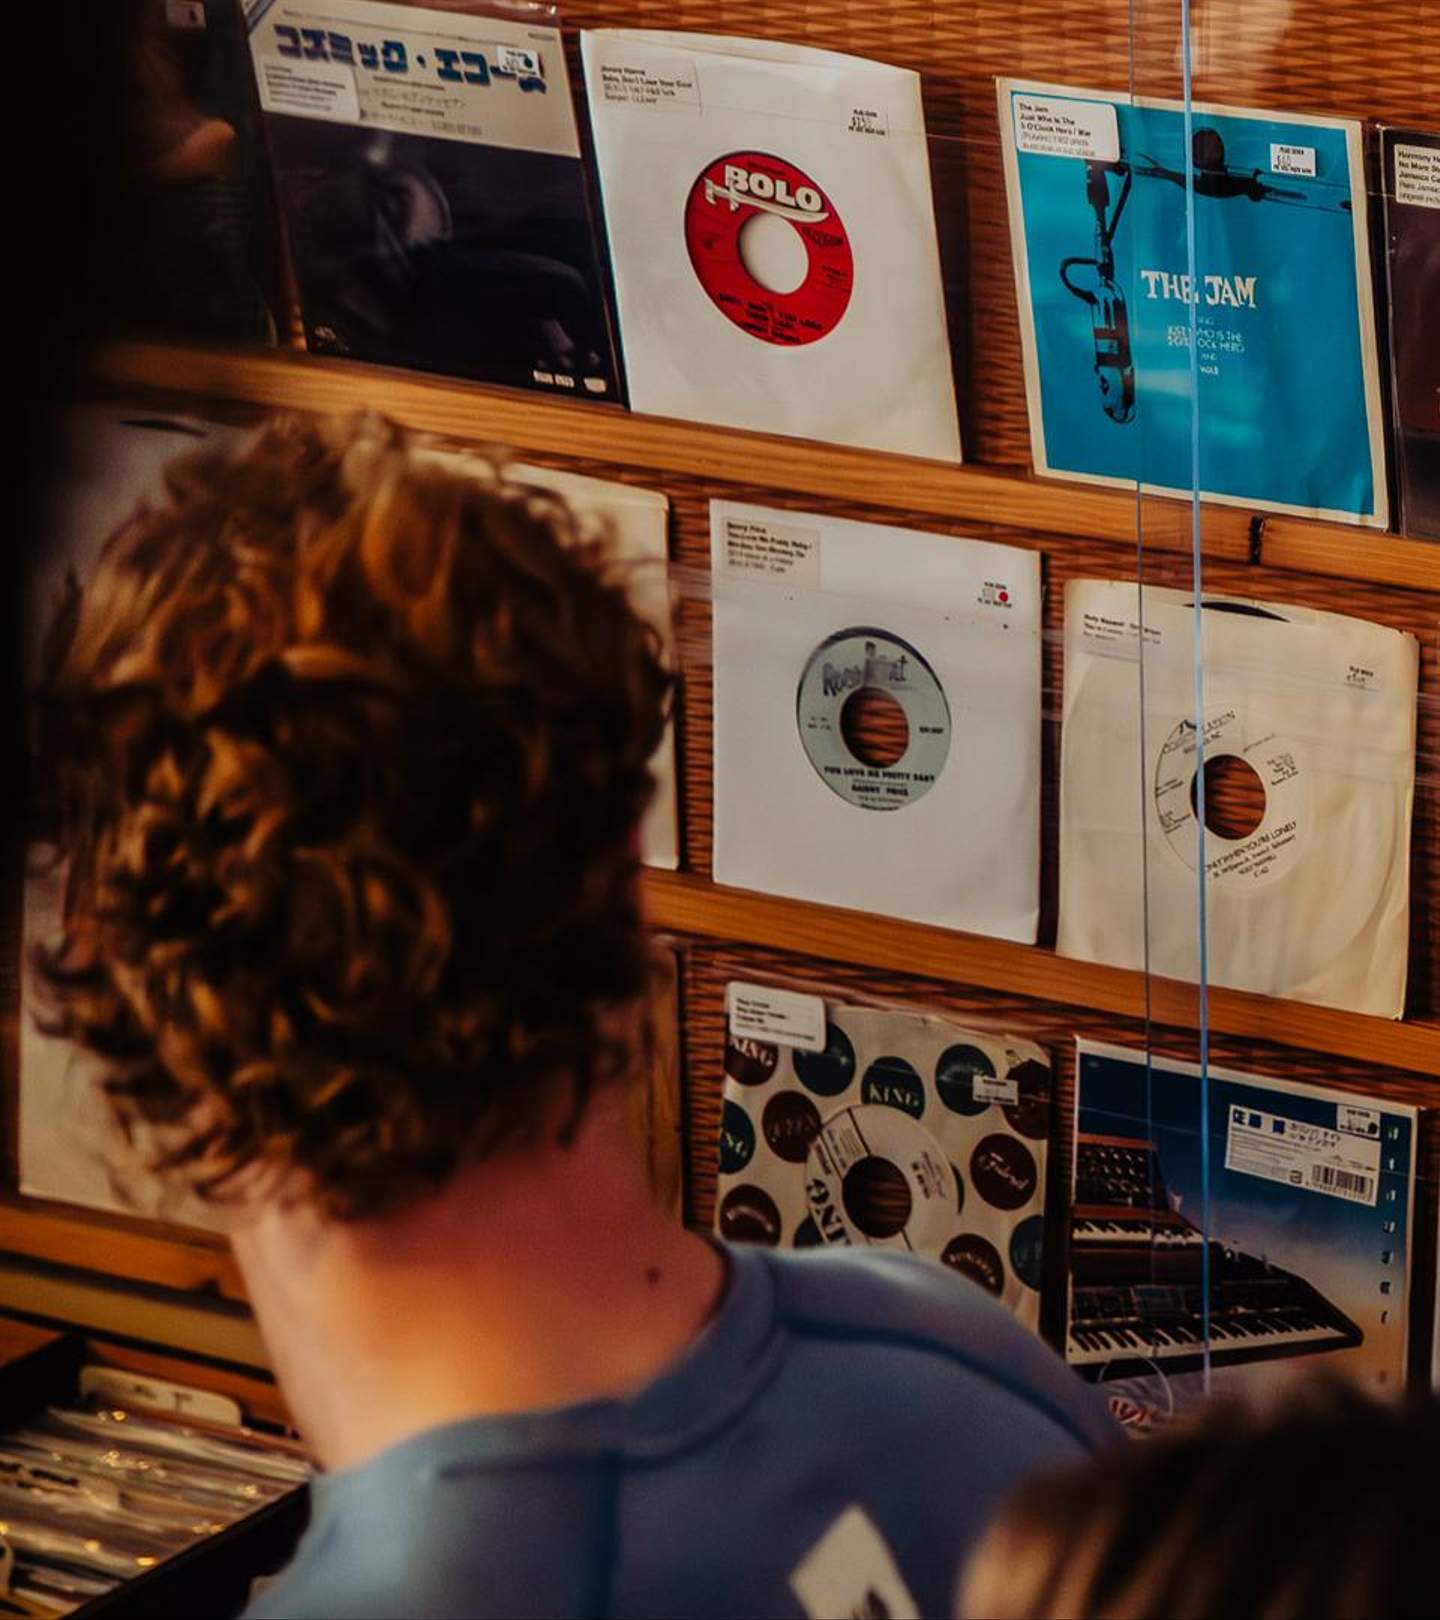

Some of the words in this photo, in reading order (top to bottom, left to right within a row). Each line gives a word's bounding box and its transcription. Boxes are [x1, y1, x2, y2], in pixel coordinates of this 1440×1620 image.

[1398, 151, 1431, 163] Harmony
[1399, 161, 1409, 169] No
[1411, 162, 1429, 171] More
[725, 164, 823, 212] BOLO
[1140, 269, 1200, 305] THE
[1204, 275, 1257, 309] JAM
[843, 767, 864, 777] LOVE
